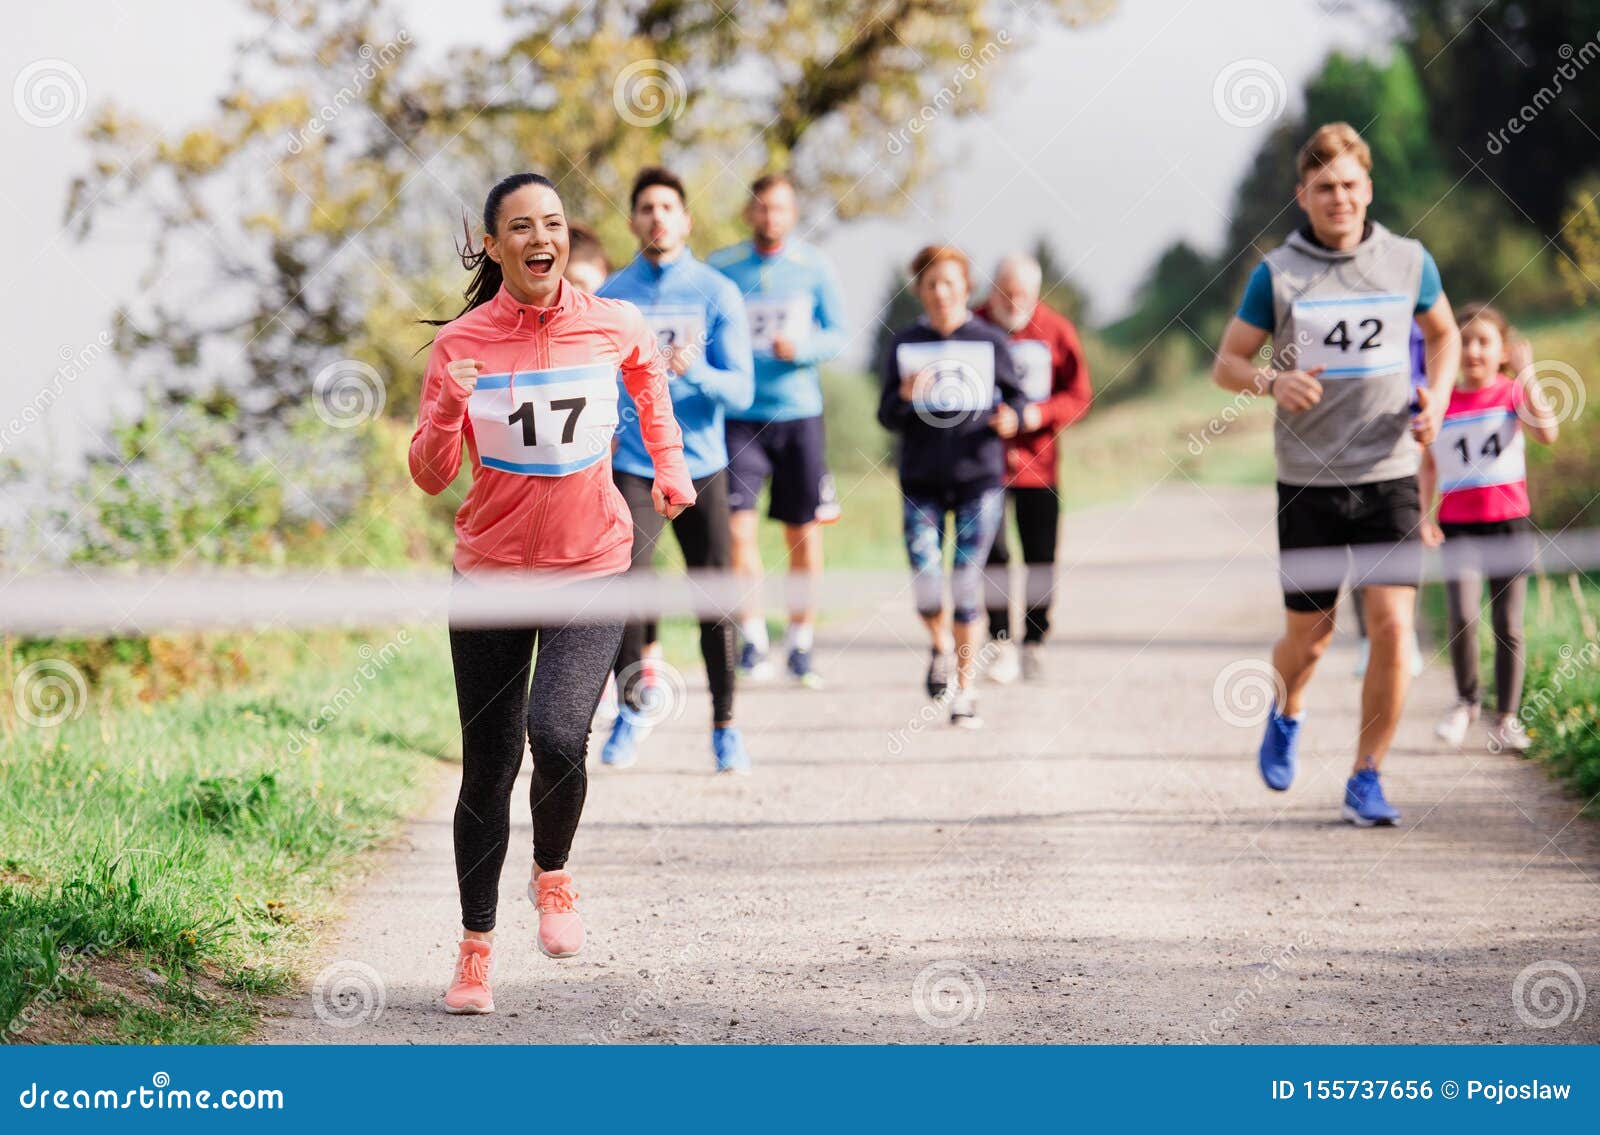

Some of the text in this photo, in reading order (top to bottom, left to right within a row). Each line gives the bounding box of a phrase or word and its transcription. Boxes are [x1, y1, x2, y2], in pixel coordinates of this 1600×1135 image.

[1323, 318, 1382, 352] 42
[508, 397, 586, 446] 17
[1454, 432, 1502, 465] 14
